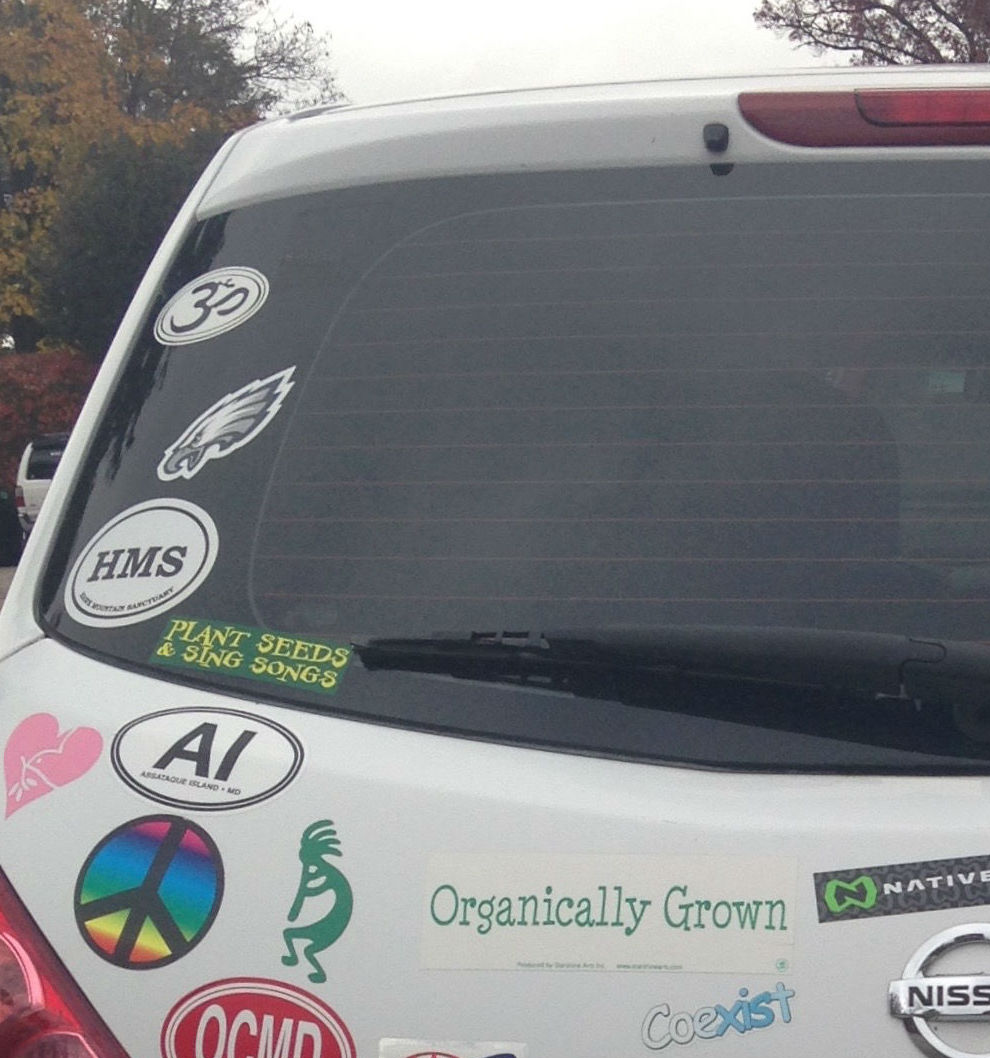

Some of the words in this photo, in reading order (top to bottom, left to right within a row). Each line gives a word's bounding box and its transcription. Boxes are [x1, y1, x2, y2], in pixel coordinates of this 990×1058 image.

[86, 545, 188, 583] HMS
[126, 586, 174, 611] SANCTUARY
[156, 642, 175, 657] &
[182, 643, 244, 670] SING
[250, 656, 339, 689] SONGS
[163, 619, 250, 648] PLANT
[256, 633, 350, 669] SEEDS
[152, 722, 258, 781] AI
[188, 779, 219, 793] ISLAND
[227, 786, 242, 796] MD
[430, 884, 651, 936] Organically
[664, 885, 788, 931] Grown
